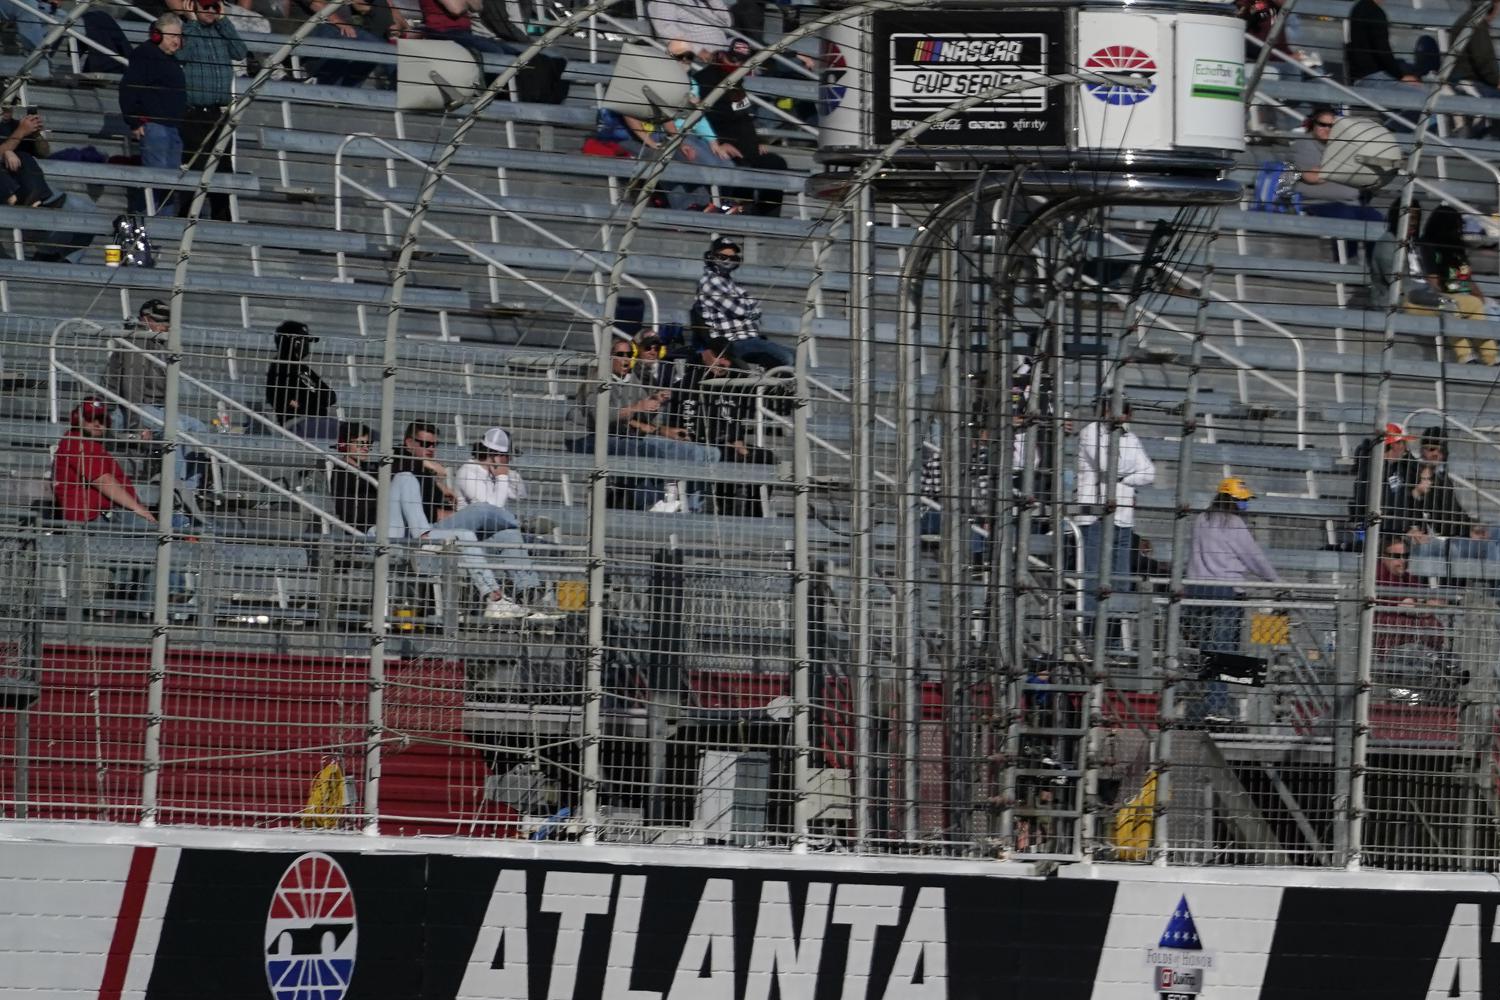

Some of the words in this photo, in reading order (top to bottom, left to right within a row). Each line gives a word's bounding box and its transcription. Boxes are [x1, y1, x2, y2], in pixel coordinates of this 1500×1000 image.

[939, 40, 1023, 62] NASCAR
[912, 73, 951, 94] CUP
[968, 120, 1008, 130] GEICO
[1012, 117, 1048, 131] xfinity
